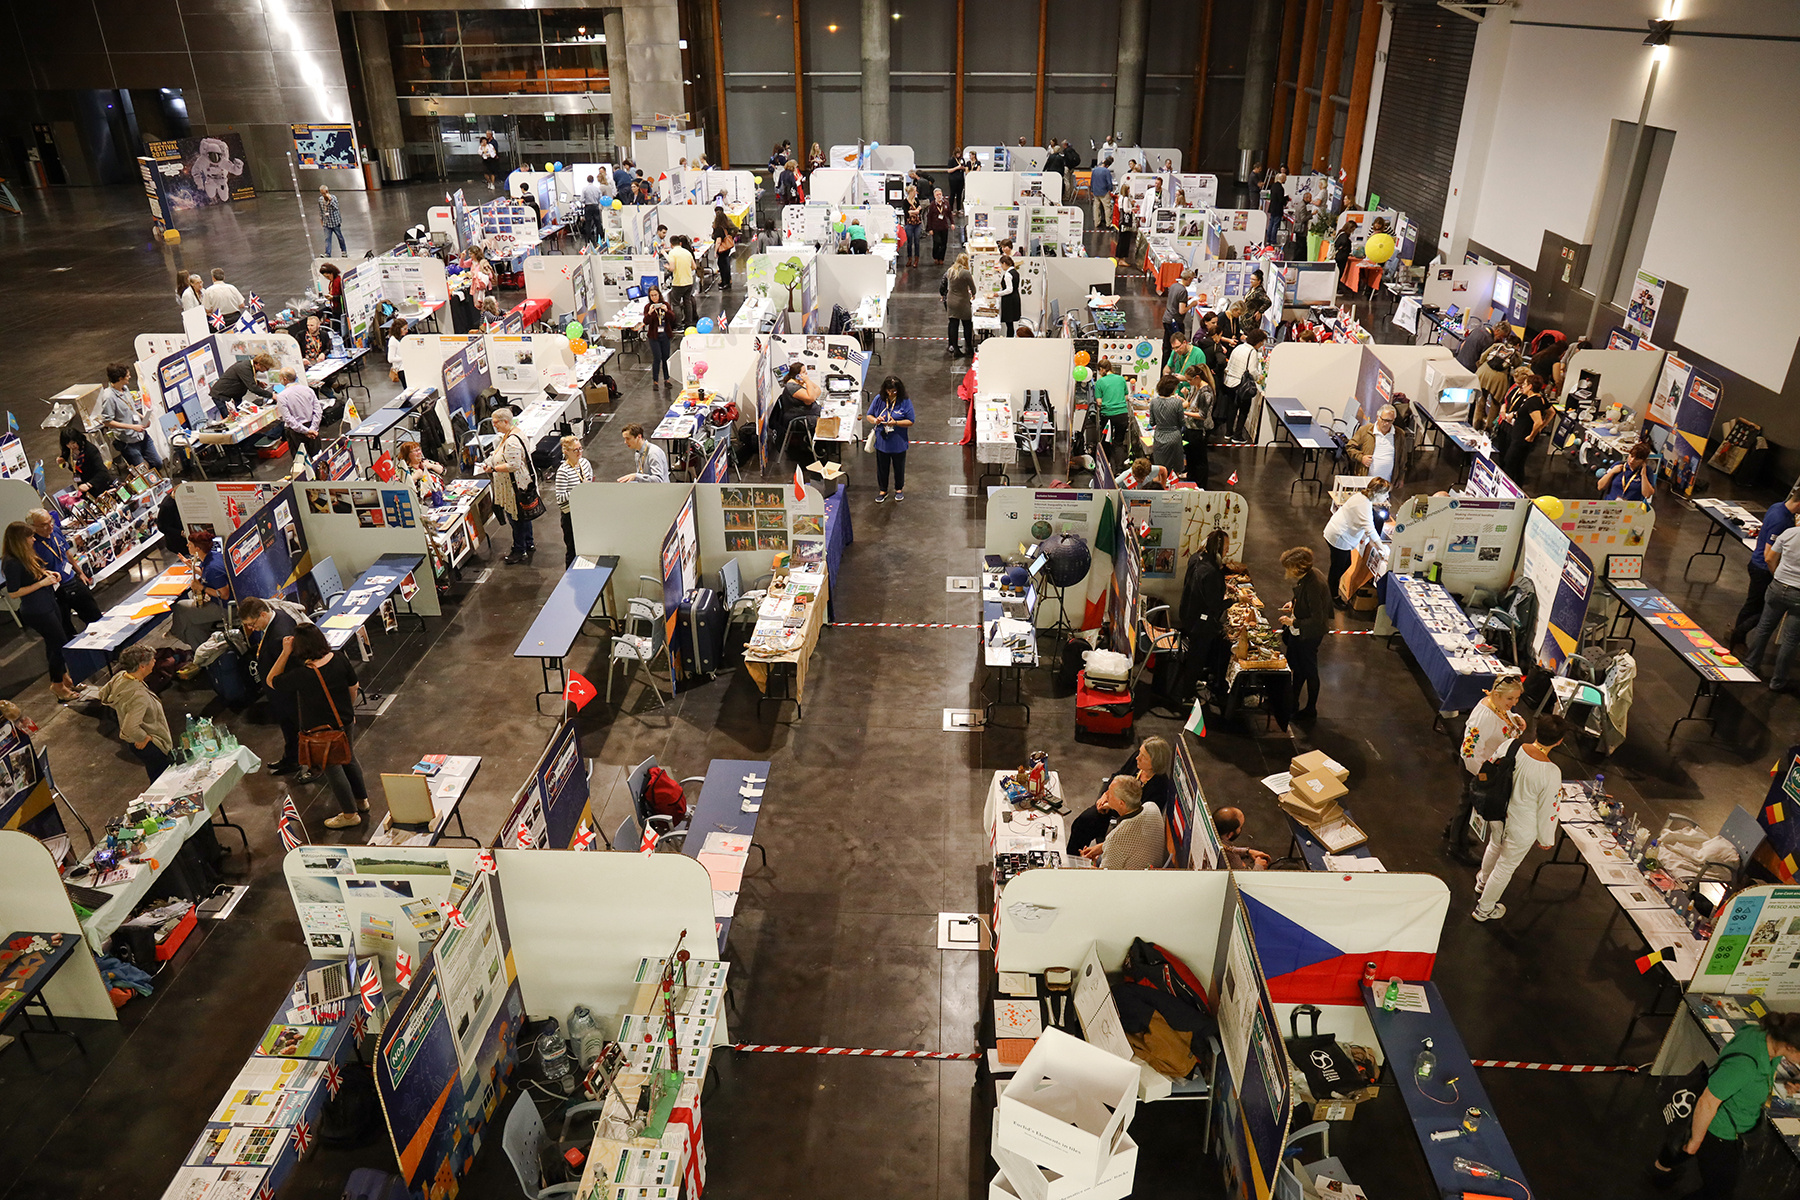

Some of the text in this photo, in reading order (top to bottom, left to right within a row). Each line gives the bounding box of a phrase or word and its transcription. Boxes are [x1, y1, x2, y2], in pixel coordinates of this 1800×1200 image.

[149, 144, 179, 152] FESTIVAL
[391, 1041, 405, 1065] N06
[1013, 1120, 1035, 1134] Euclid's
[1036, 1130, 1061, 1146] Elements
